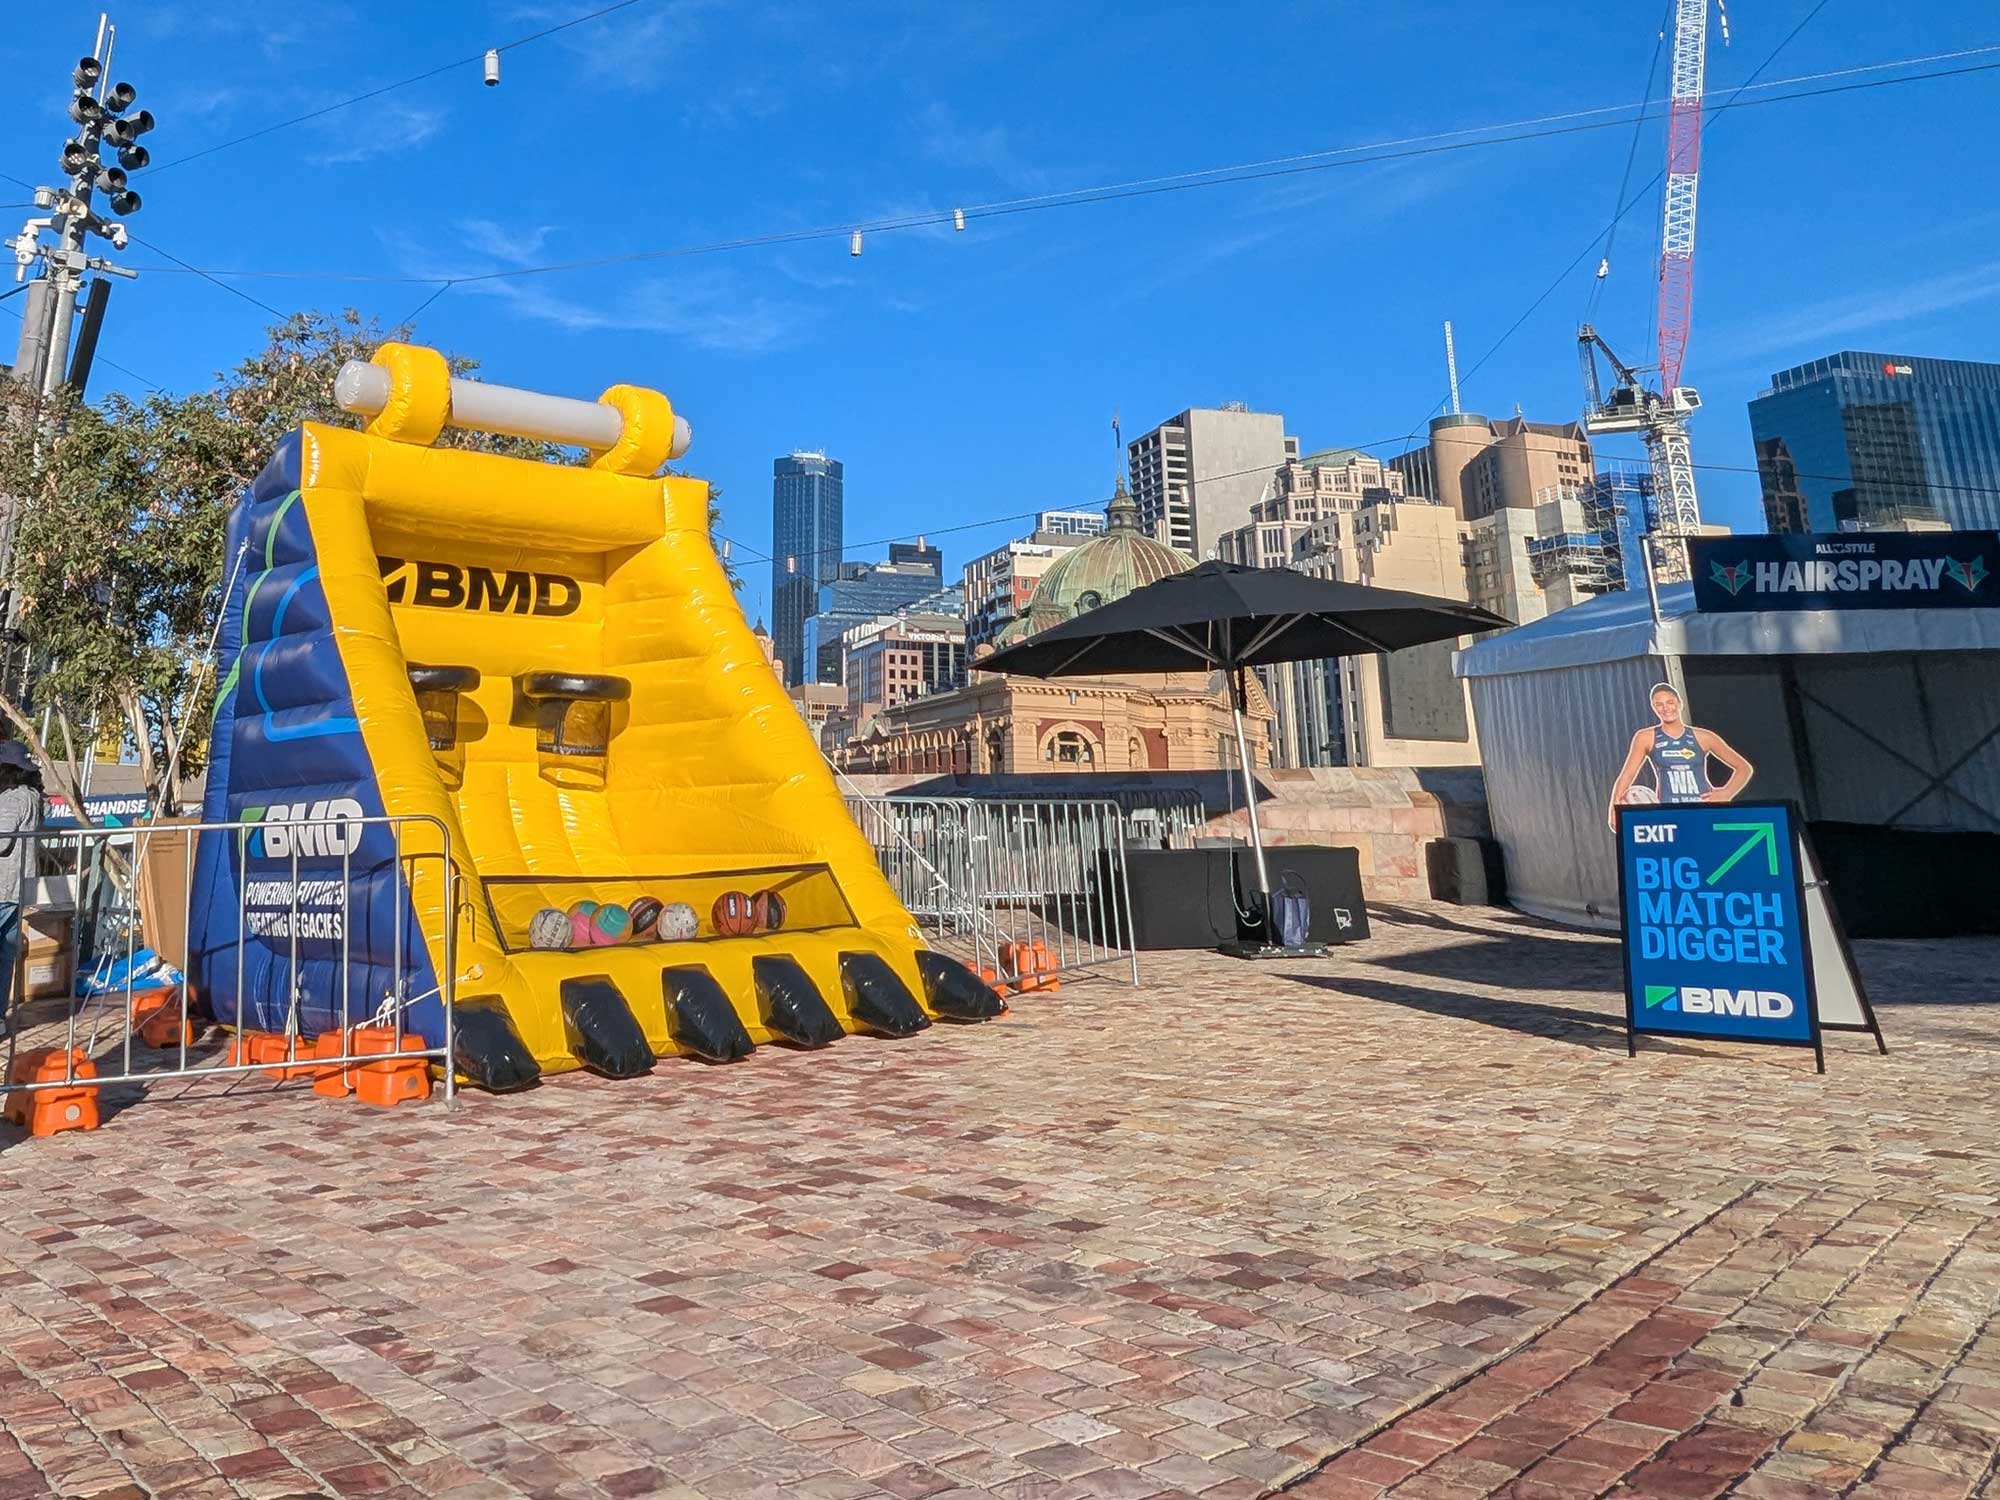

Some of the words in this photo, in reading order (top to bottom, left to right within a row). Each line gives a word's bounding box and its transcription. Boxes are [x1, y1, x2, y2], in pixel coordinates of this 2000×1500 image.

[1845, 543, 1875, 553] STYLE
[413, 561, 581, 616] BMD
[1755, 558, 1945, 592] HAIRSPRAY
[1667, 770, 1699, 794] WA
[52, 799, 147, 818] MECHANDISE
[264, 798, 363, 858] BMD
[1633, 824, 1678, 843] EXIT
[1636, 857, 1700, 889] BIG
[245, 881, 293, 905] POWERING
[1638, 891, 1784, 926] MATCH
[1641, 926, 1788, 964] DIGGER
[1681, 987, 1794, 1018] BMD
